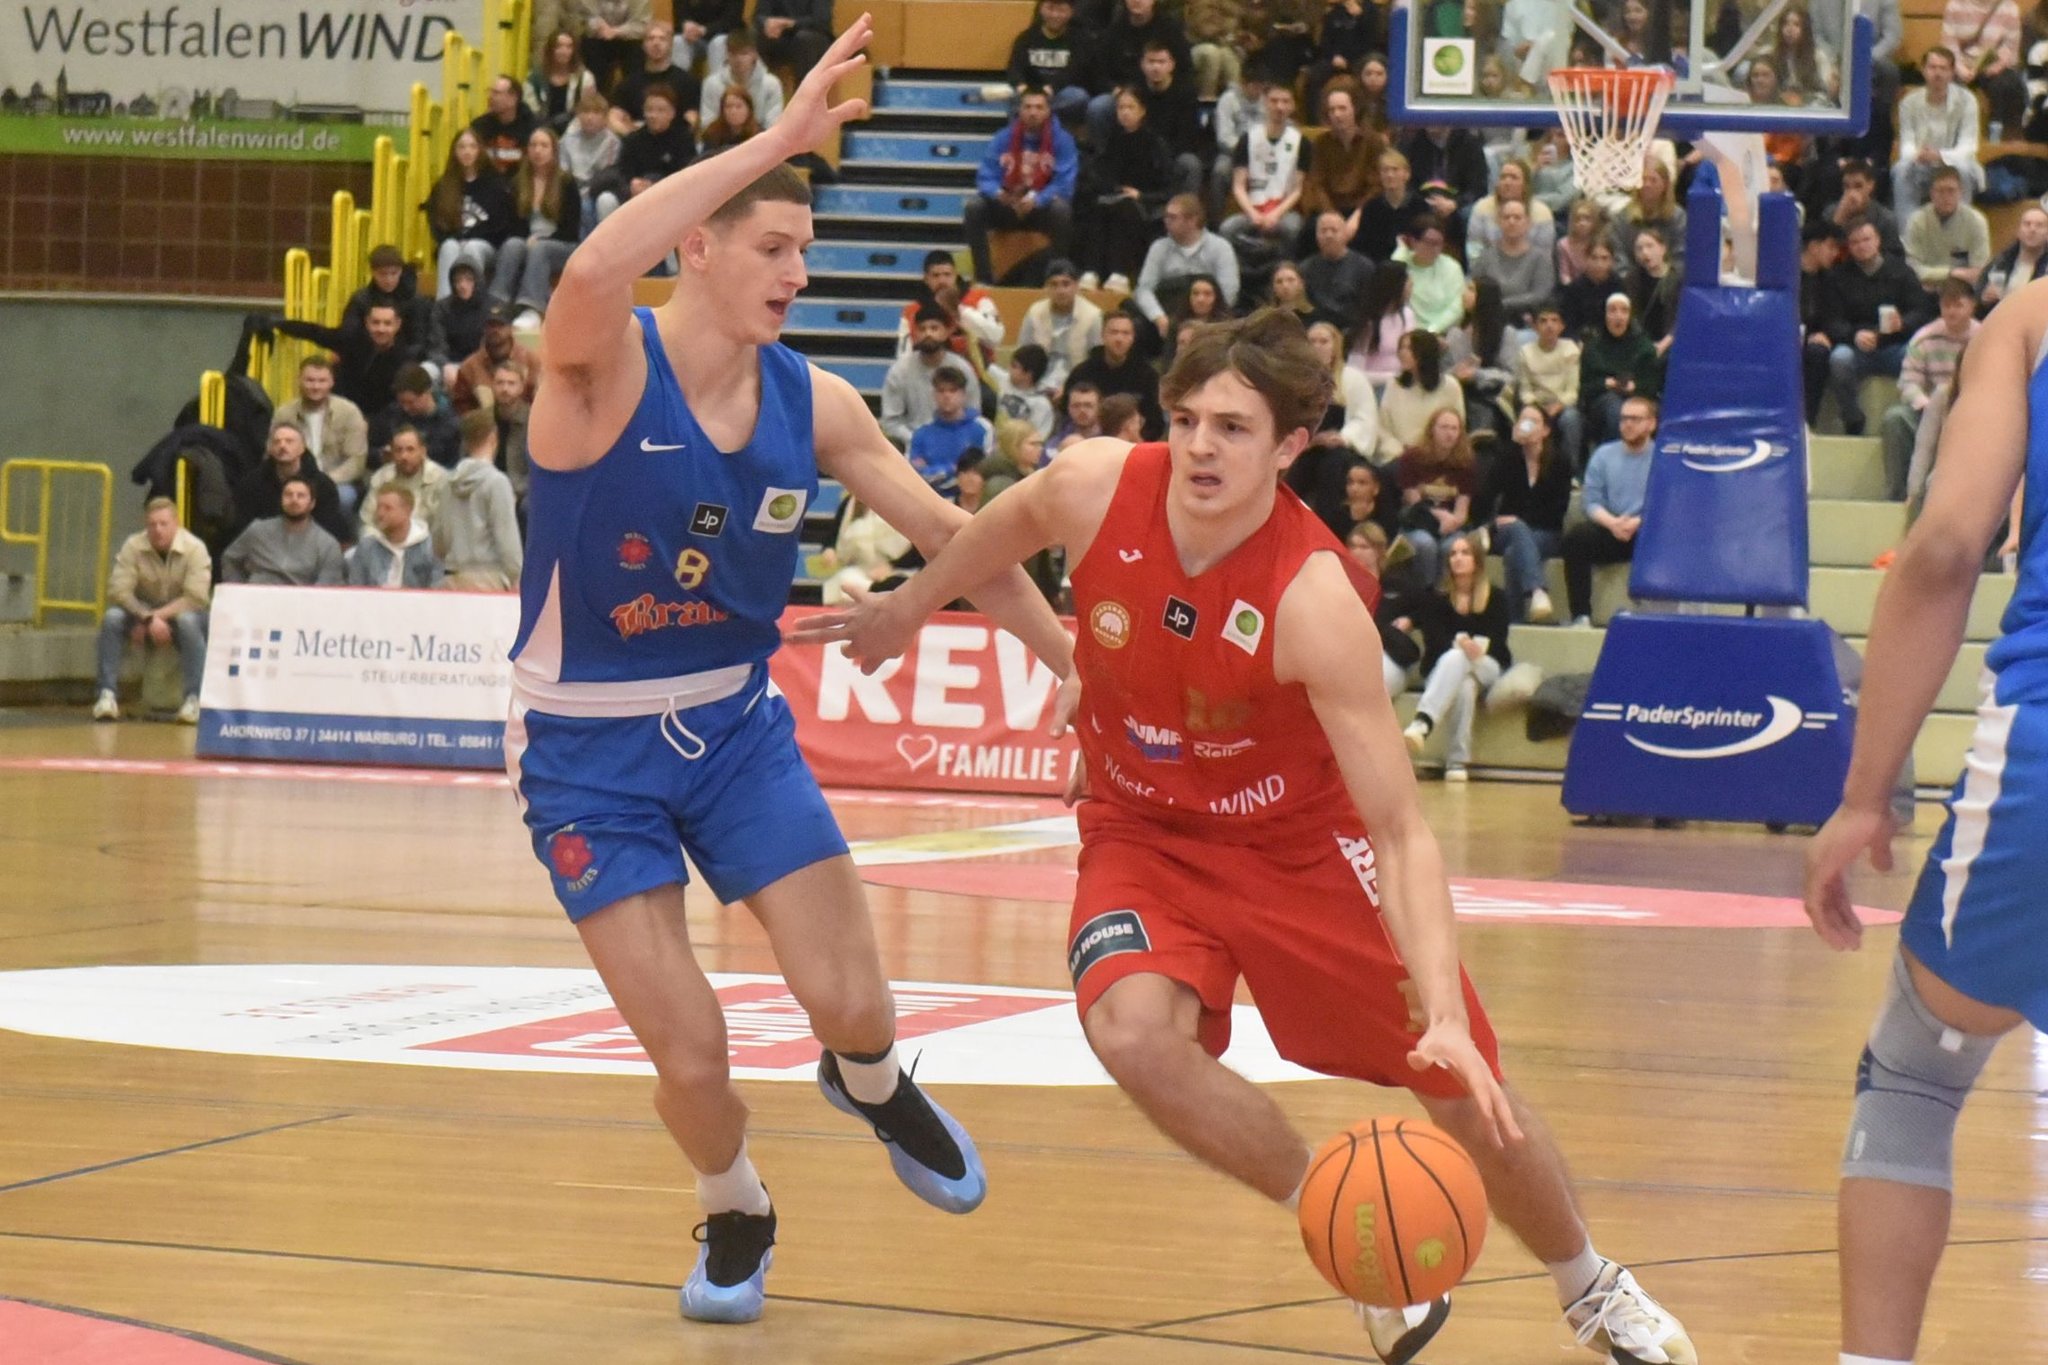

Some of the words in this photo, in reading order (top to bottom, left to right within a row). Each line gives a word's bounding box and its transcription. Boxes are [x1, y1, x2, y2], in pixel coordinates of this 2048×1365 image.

[62, 124, 341, 153] www.westfalenwind.de
[674, 548, 710, 590] 8
[294, 629, 482, 664] Metten-Maas
[219, 723, 292, 742] AHORNWEG
[1625, 704, 1763, 730] PaderSprinter
[937, 743, 1060, 781] FAMILIE
